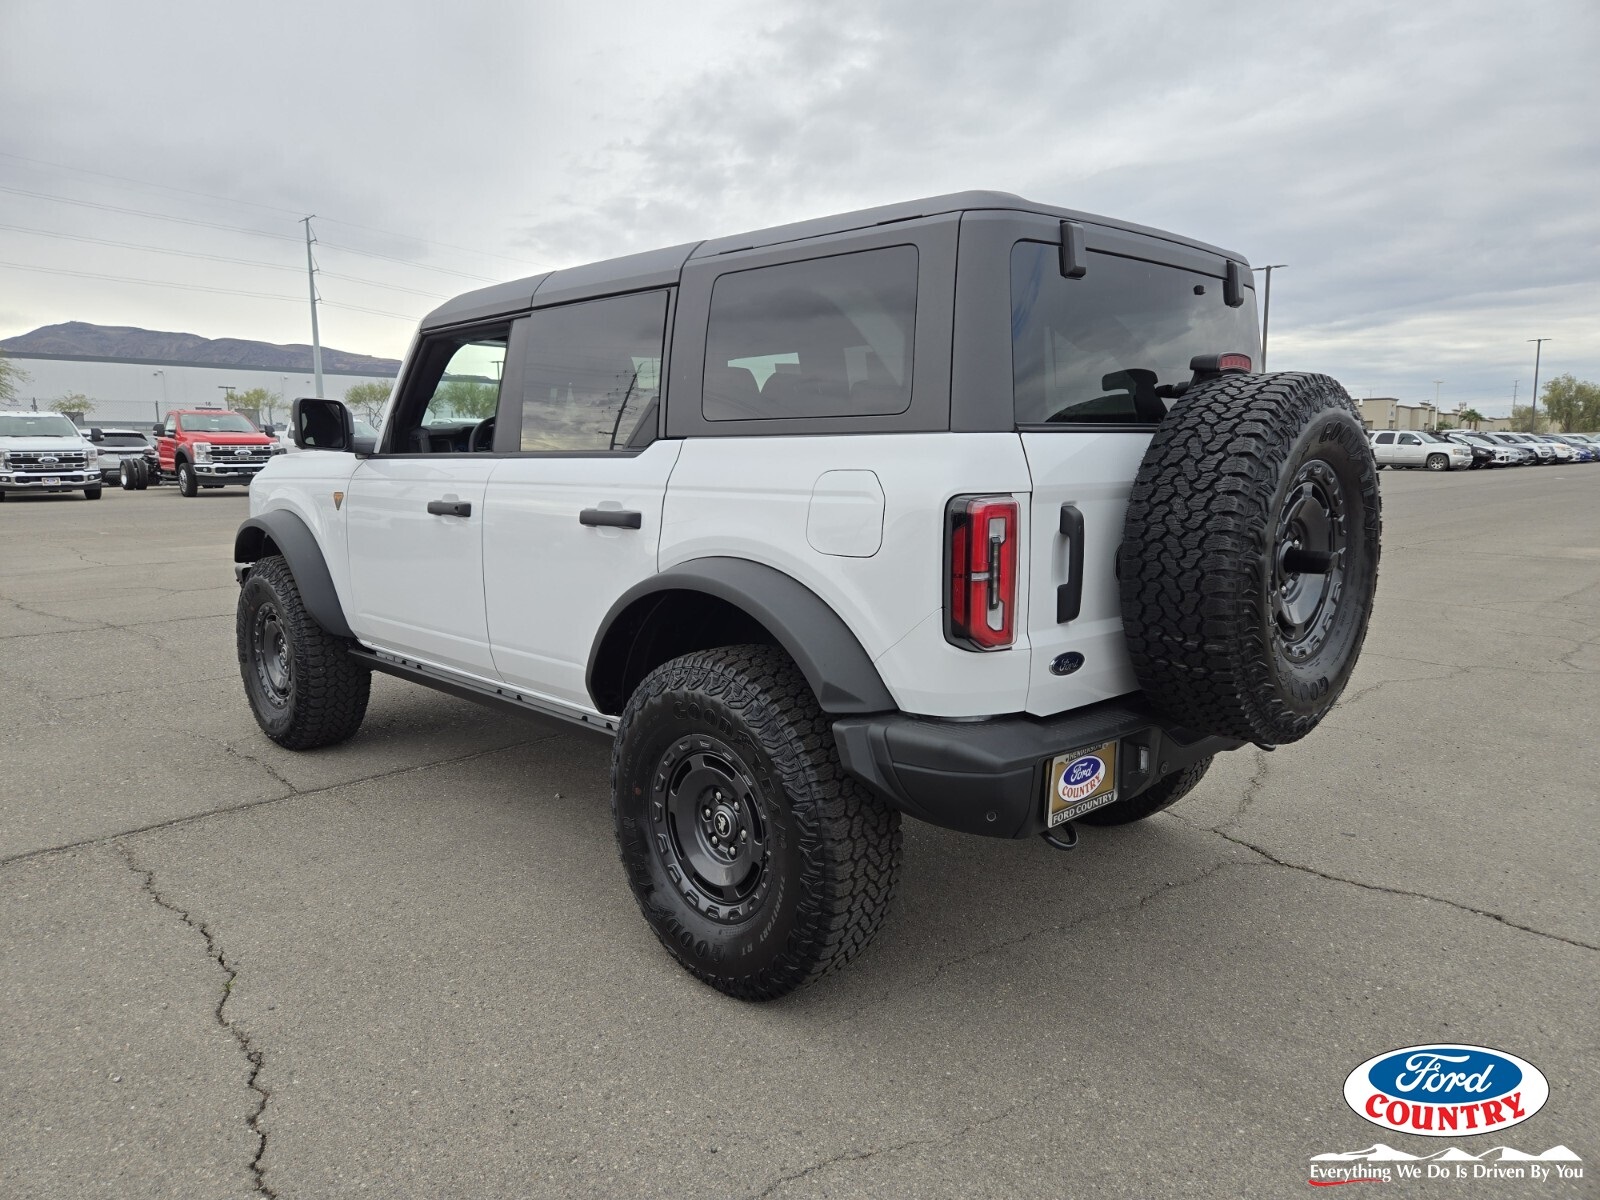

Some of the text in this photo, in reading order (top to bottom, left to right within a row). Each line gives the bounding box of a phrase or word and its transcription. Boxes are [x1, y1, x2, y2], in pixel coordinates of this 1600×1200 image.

[1070, 762, 1094, 783] Ford
[1062, 773, 1101, 798] COUNTRY
[1053, 793, 1114, 824] FORD COUNTRY
